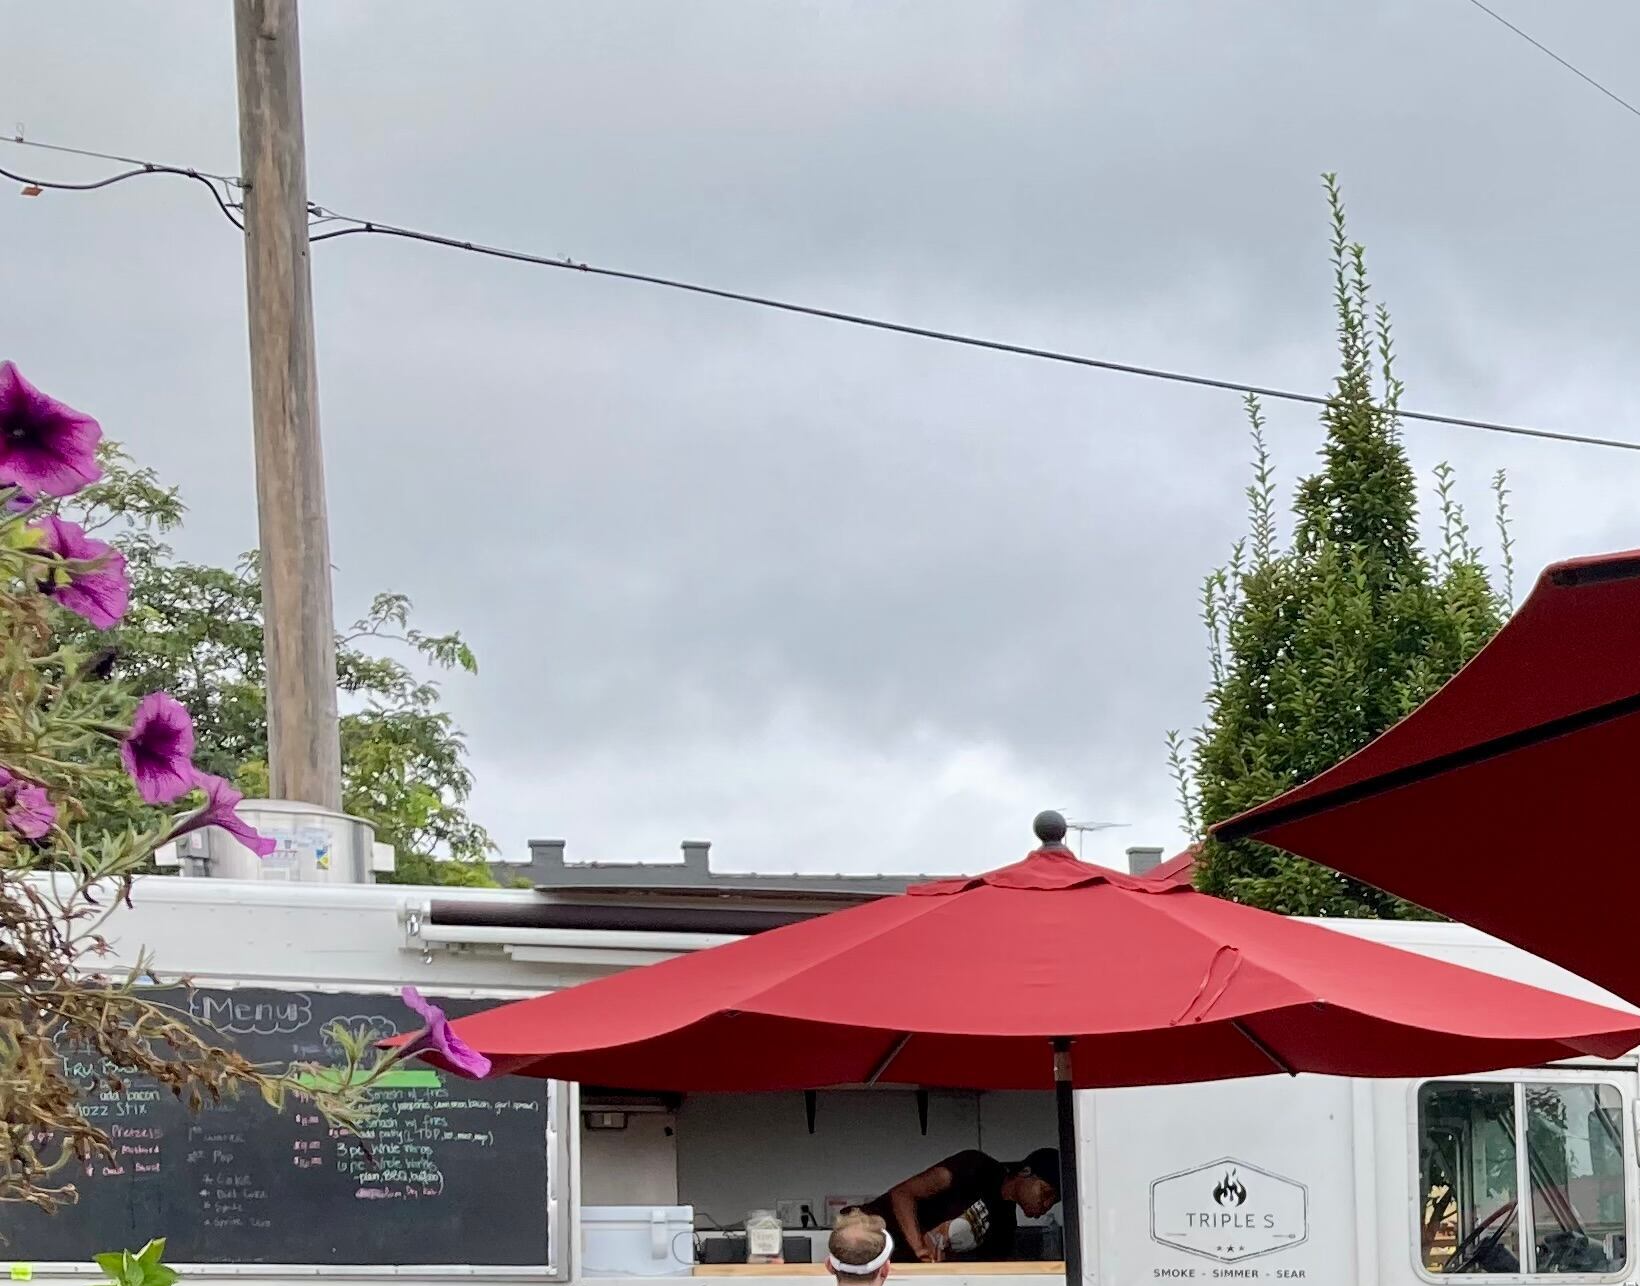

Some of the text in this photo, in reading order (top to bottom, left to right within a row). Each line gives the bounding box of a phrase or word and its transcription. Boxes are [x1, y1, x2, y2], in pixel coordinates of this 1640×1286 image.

[204, 996, 299, 1023] Menu
[126, 1089, 160, 1101] bacon
[337, 1144, 348, 1155] 3
[1186, 1213, 1275, 1229] TRIPLE S
[1153, 1268, 1306, 1279] SMOKE SIMMER SEAR
